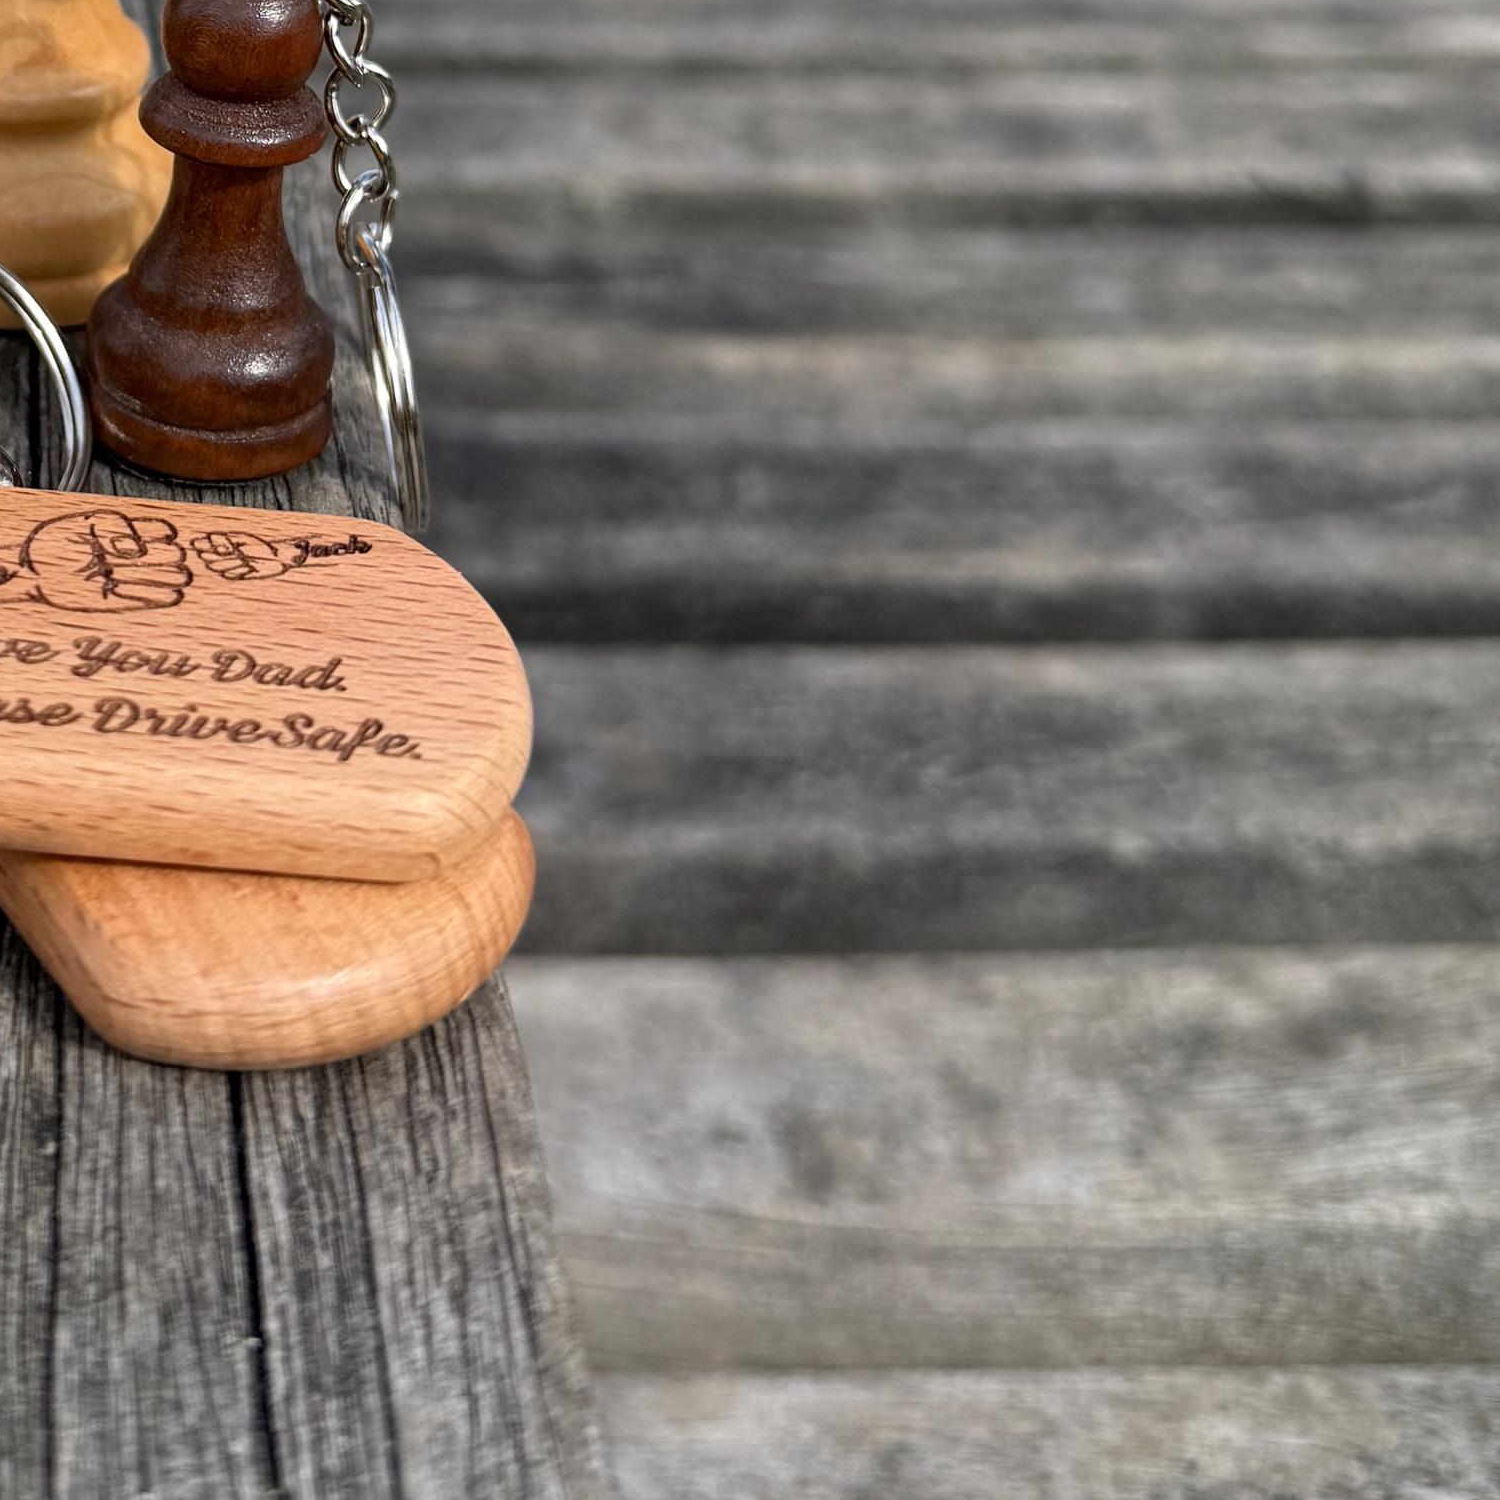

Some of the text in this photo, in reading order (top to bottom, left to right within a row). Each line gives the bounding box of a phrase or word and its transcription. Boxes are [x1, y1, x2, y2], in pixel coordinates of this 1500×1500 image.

[290, 533, 373, 565] Jack
[70, 635, 200, 678] You
[210, 649, 348, 692] Dad.
